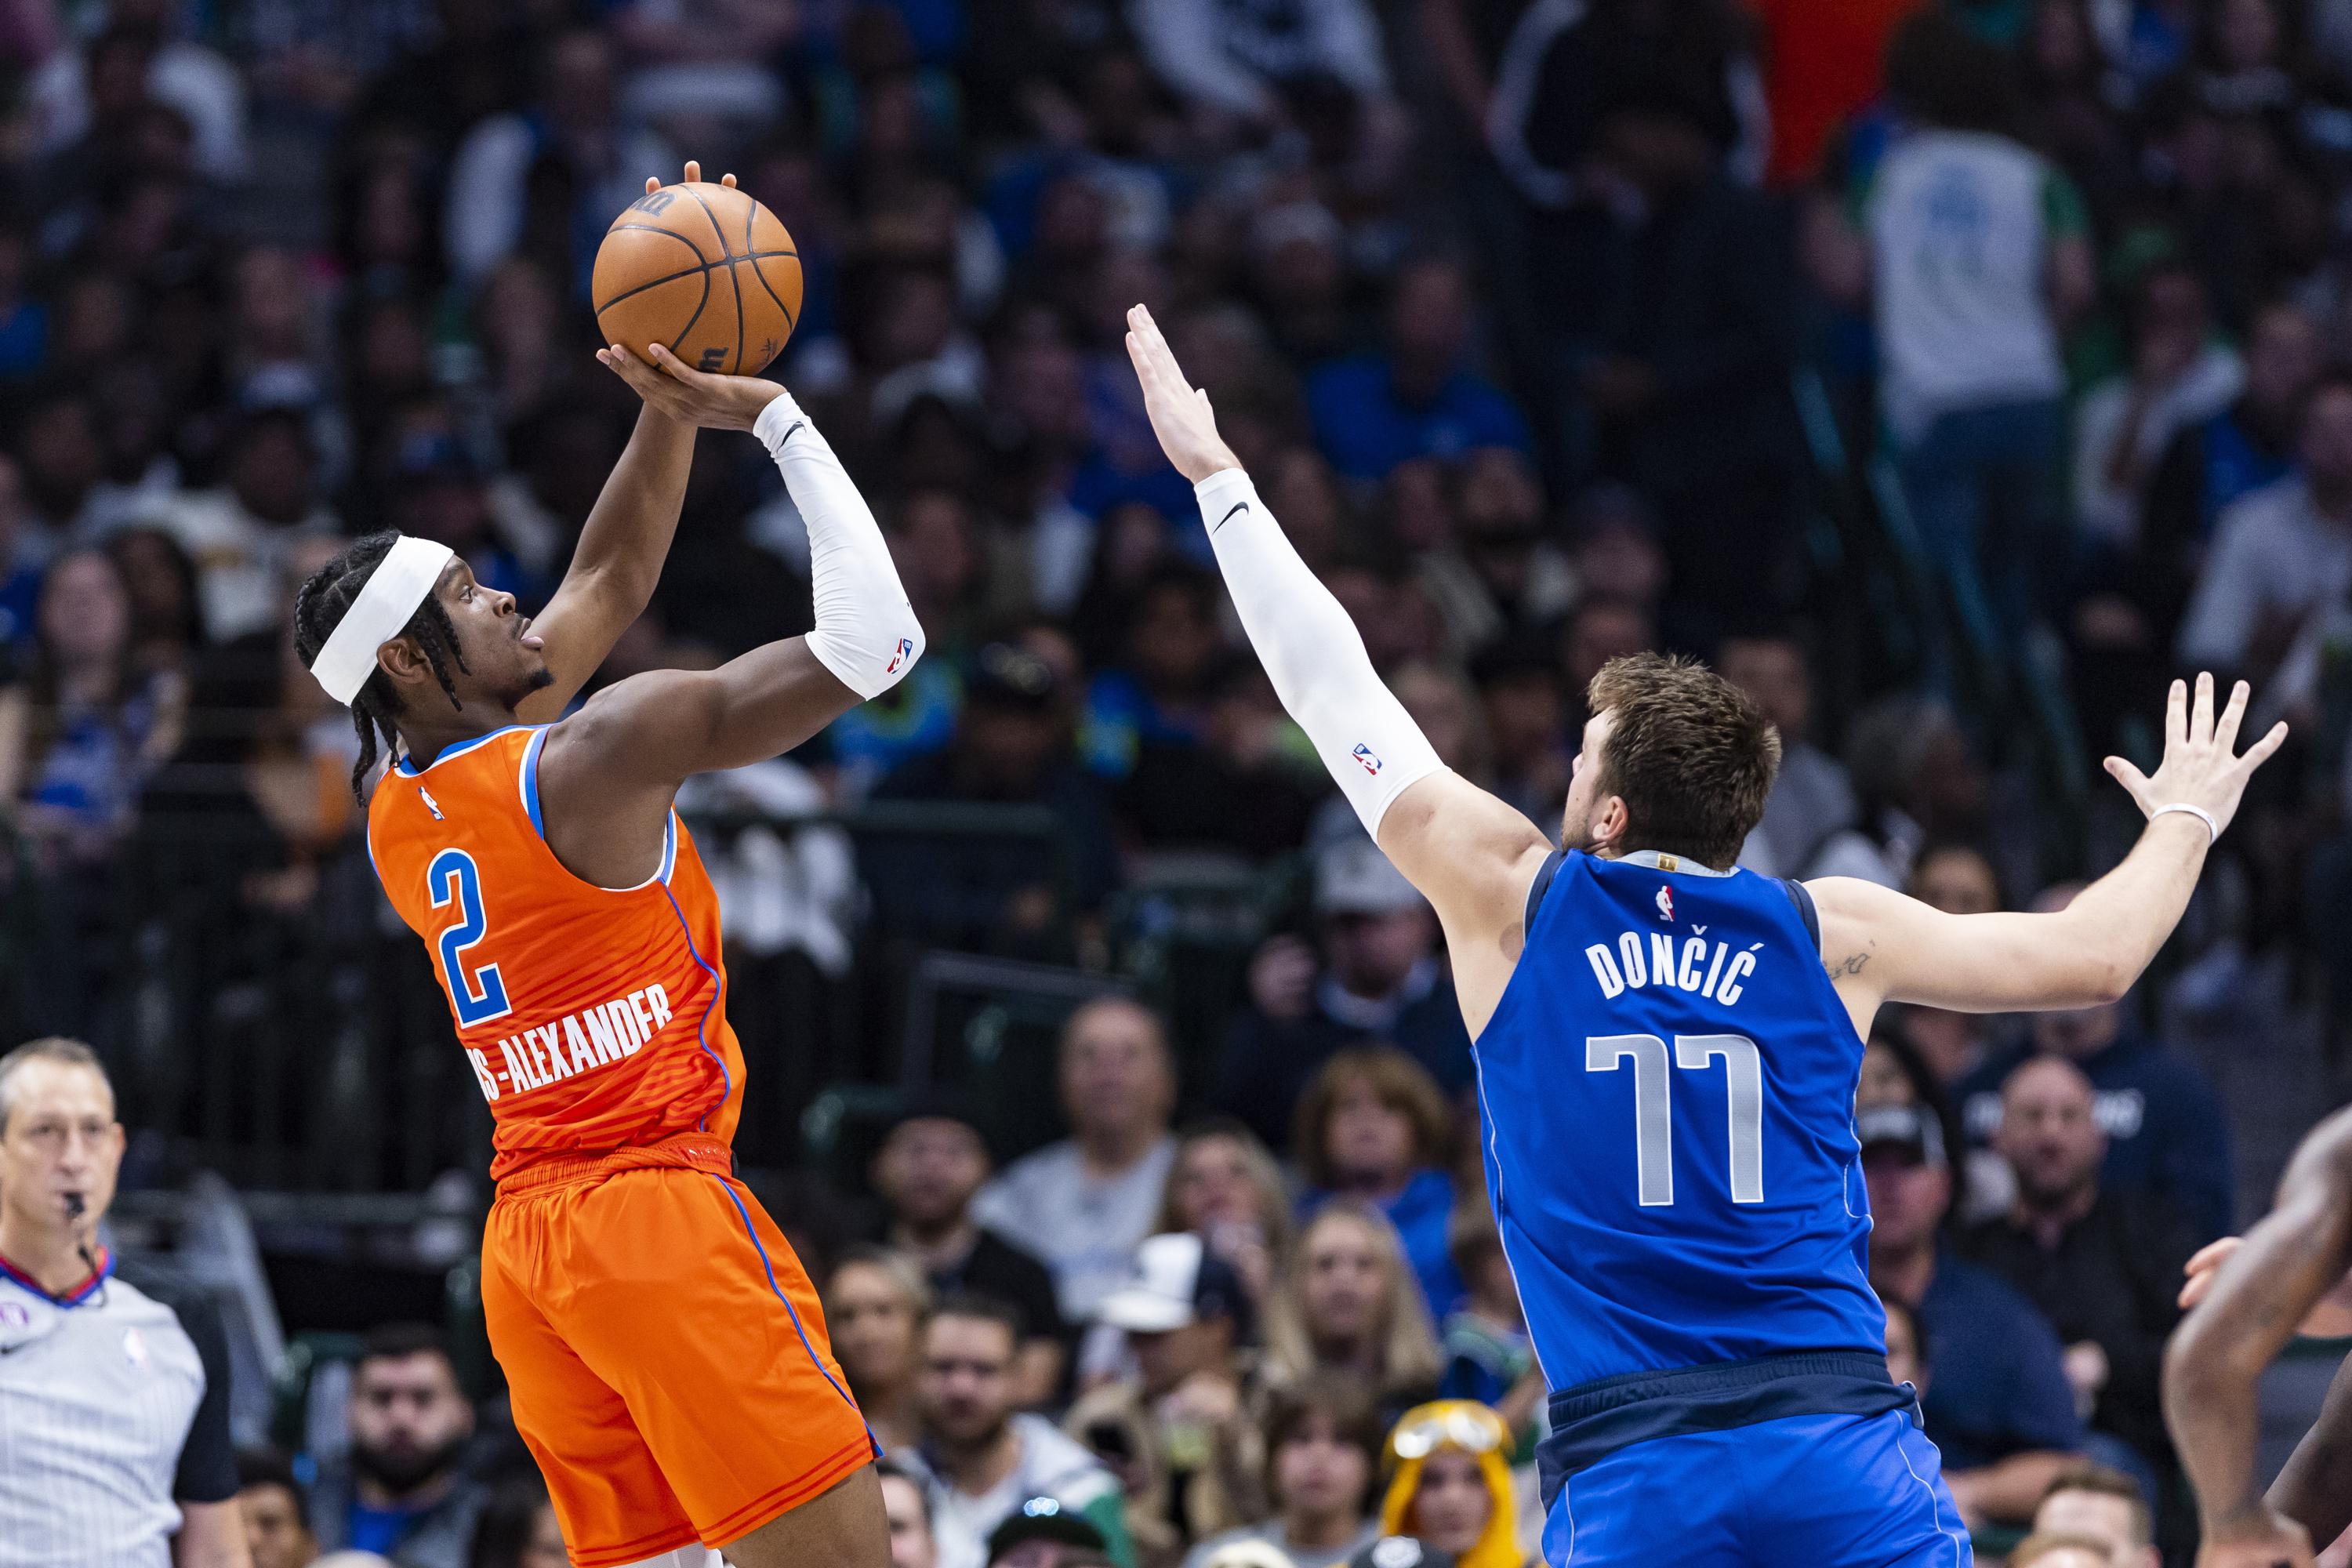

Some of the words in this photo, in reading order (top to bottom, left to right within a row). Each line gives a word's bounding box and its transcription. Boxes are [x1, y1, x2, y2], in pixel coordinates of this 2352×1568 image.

[426, 847, 513, 1029] 2
[1585, 924, 1765, 1007] DONČIĆ
[1585, 1033, 1764, 1207] 77
